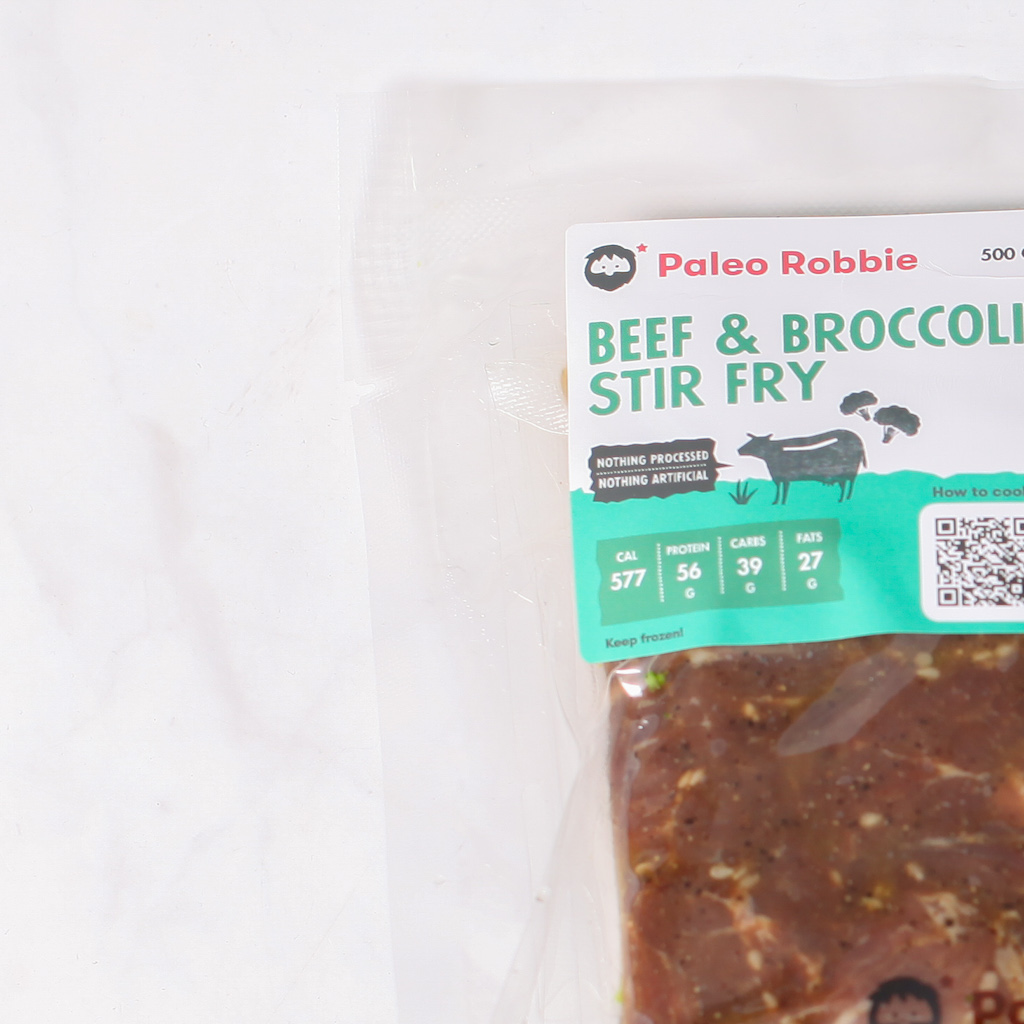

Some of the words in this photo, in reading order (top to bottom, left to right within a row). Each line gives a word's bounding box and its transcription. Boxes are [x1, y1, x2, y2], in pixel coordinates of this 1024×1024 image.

[658, 250, 768, 277] Paleo
[782, 247, 918, 275] Robbie
[981, 247, 1015, 262] 500
[589, 315, 693, 365] BEEF
[716, 313, 760, 356] &
[783, 303, 1024, 354] BROCCOLI
[590, 364, 705, 415] STIR
[727, 360, 826, 404] FRY
[597, 455, 647, 469] NOTHING
[651, 450, 709, 465] PROCESSED
[599, 475, 648, 489] NOTHING
[651, 470, 709, 485] ARTIFICIAL
[932, 486, 967, 498] How
[972, 487, 988, 497] to
[729, 536, 767, 549] CARBS
[796, 531, 823, 544] FATS
[616, 551, 638, 563] CAL
[666, 542, 710, 556] PROTEIN
[736, 557, 763, 576] 39
[797, 551, 823, 571] 27
[610, 568, 647, 591] 577
[676, 562, 702, 582] 56
[745, 583, 756, 594] G
[807, 578, 818, 589] G
[684, 588, 695, 599] G
[605, 635, 637, 649] Keep
[640, 628, 684, 643] frozen!
